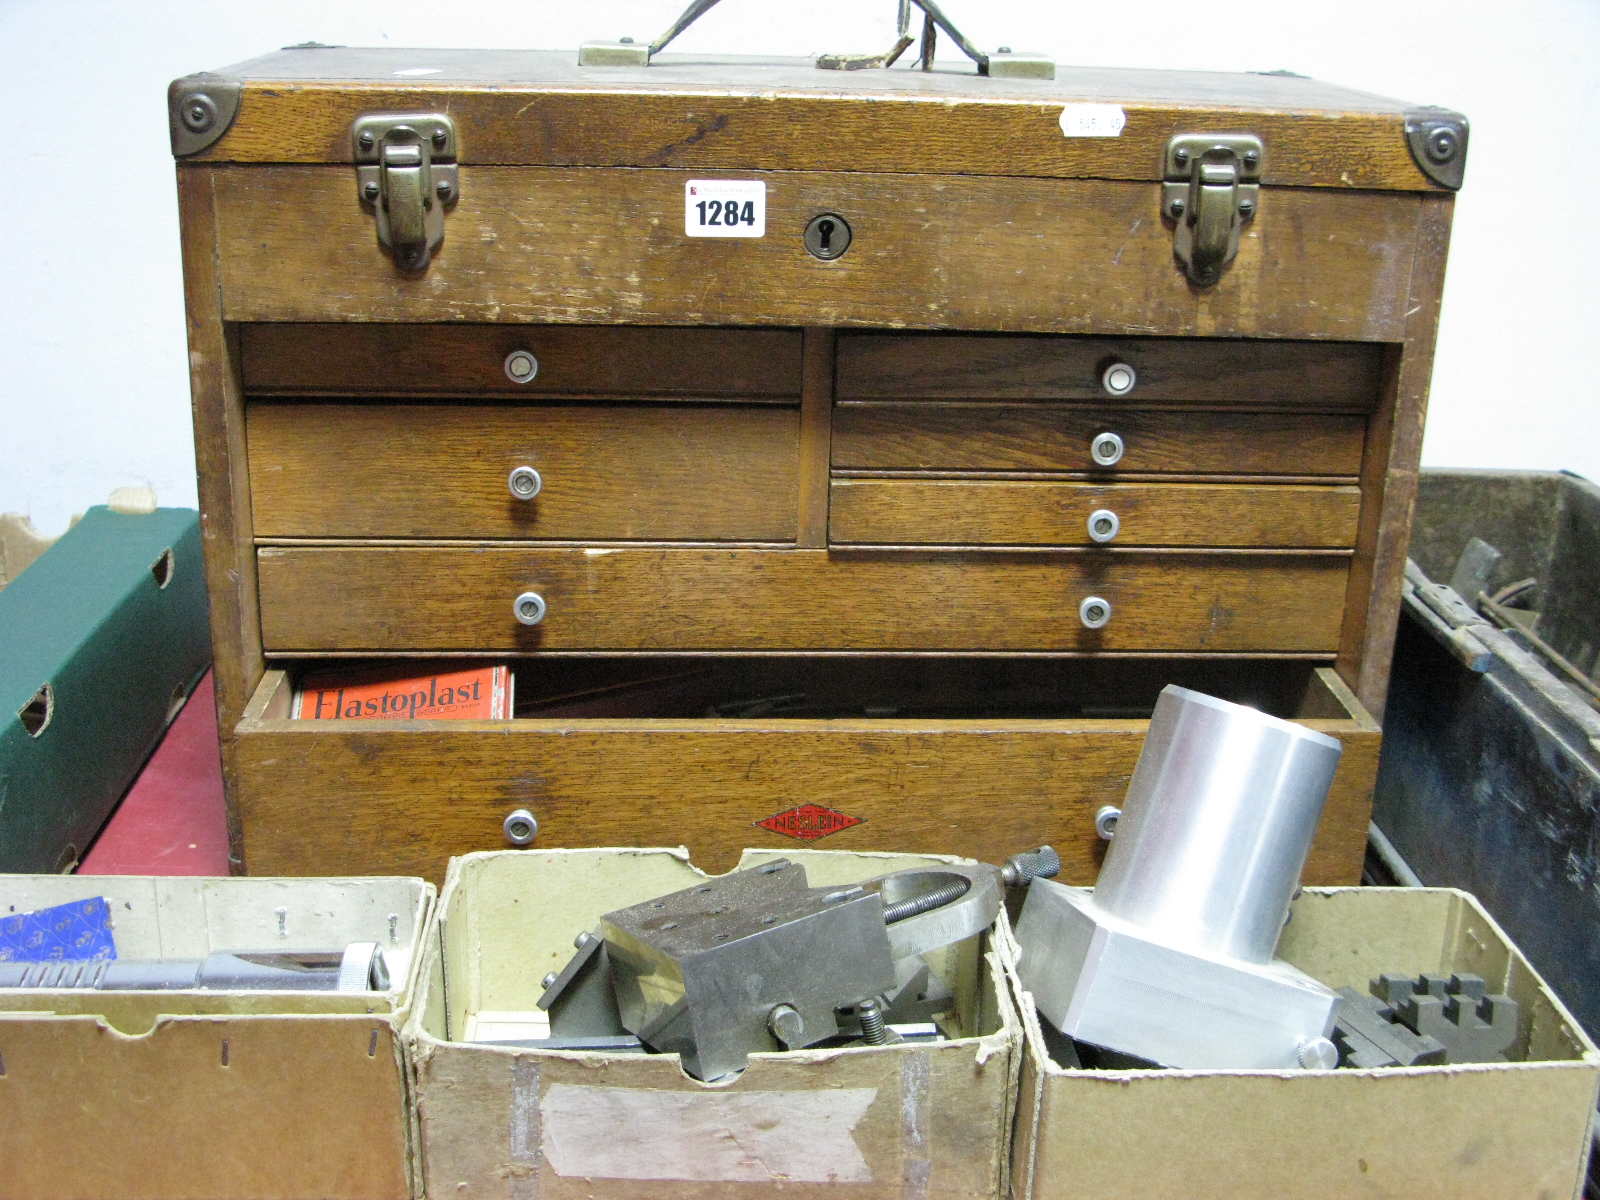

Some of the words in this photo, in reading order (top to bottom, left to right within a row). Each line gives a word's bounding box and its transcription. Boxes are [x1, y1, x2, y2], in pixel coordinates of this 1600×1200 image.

[695, 200, 756, 226] 1284
[315, 677, 482, 719] Elastoplast
[775, 814, 845, 831] NESLEIN
